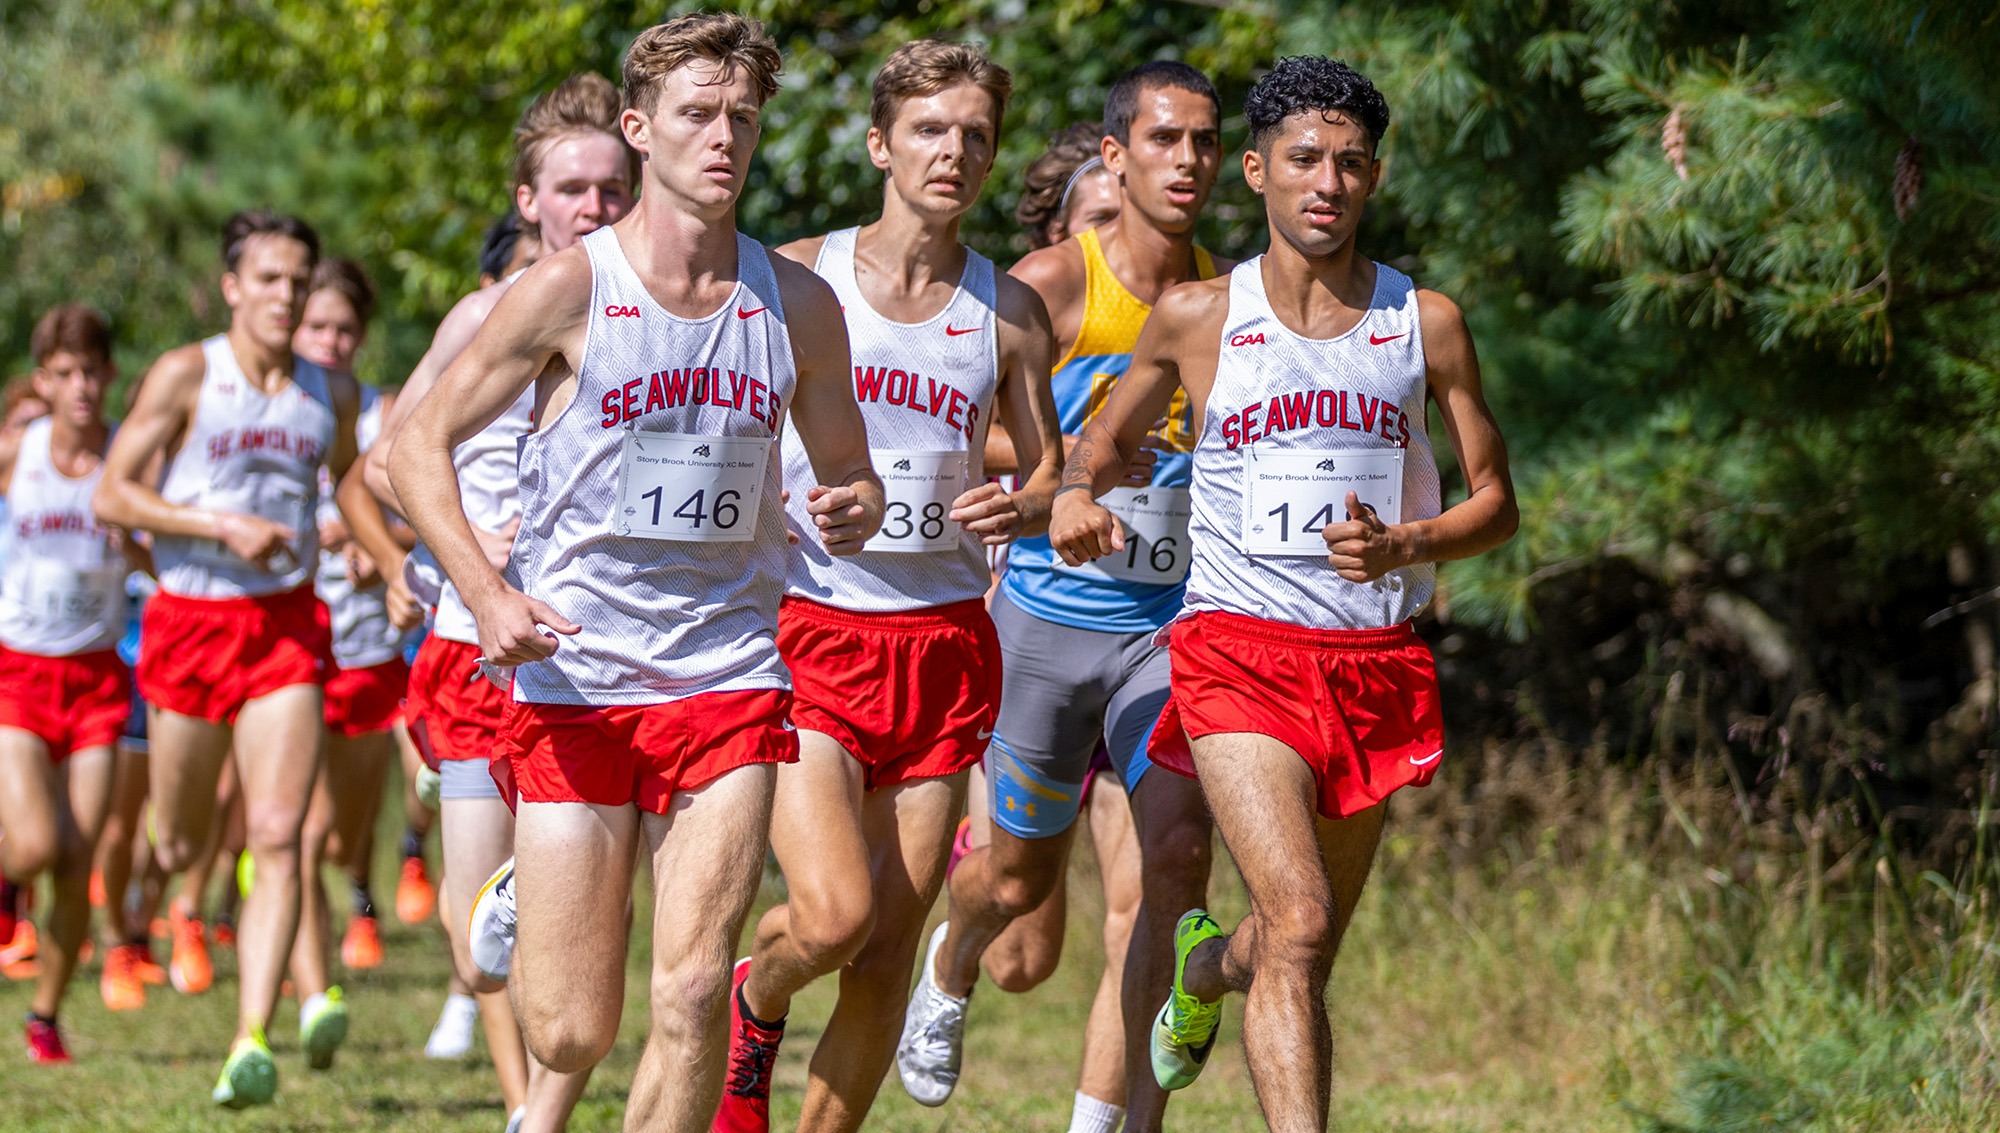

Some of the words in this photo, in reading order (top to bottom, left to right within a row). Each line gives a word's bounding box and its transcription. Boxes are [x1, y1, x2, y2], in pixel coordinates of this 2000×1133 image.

[605, 305, 641, 318] CAA
[1231, 333, 1266, 347] CAA
[601, 367, 781, 433] SEAWOLVES
[854, 366, 979, 443] WOLVES
[1222, 390, 1411, 450] SEAWOLVES
[636, 455, 660, 464] Stony
[661, 457, 686, 466] Brook
[687, 460, 725, 469] University
[889, 474, 928, 482] University
[1259, 473, 1283, 482] Stony
[1312, 475, 1353, 483] University
[641, 485, 741, 530] 146
[881, 502, 944, 540] 38
[1125, 534, 1177, 573] 16
